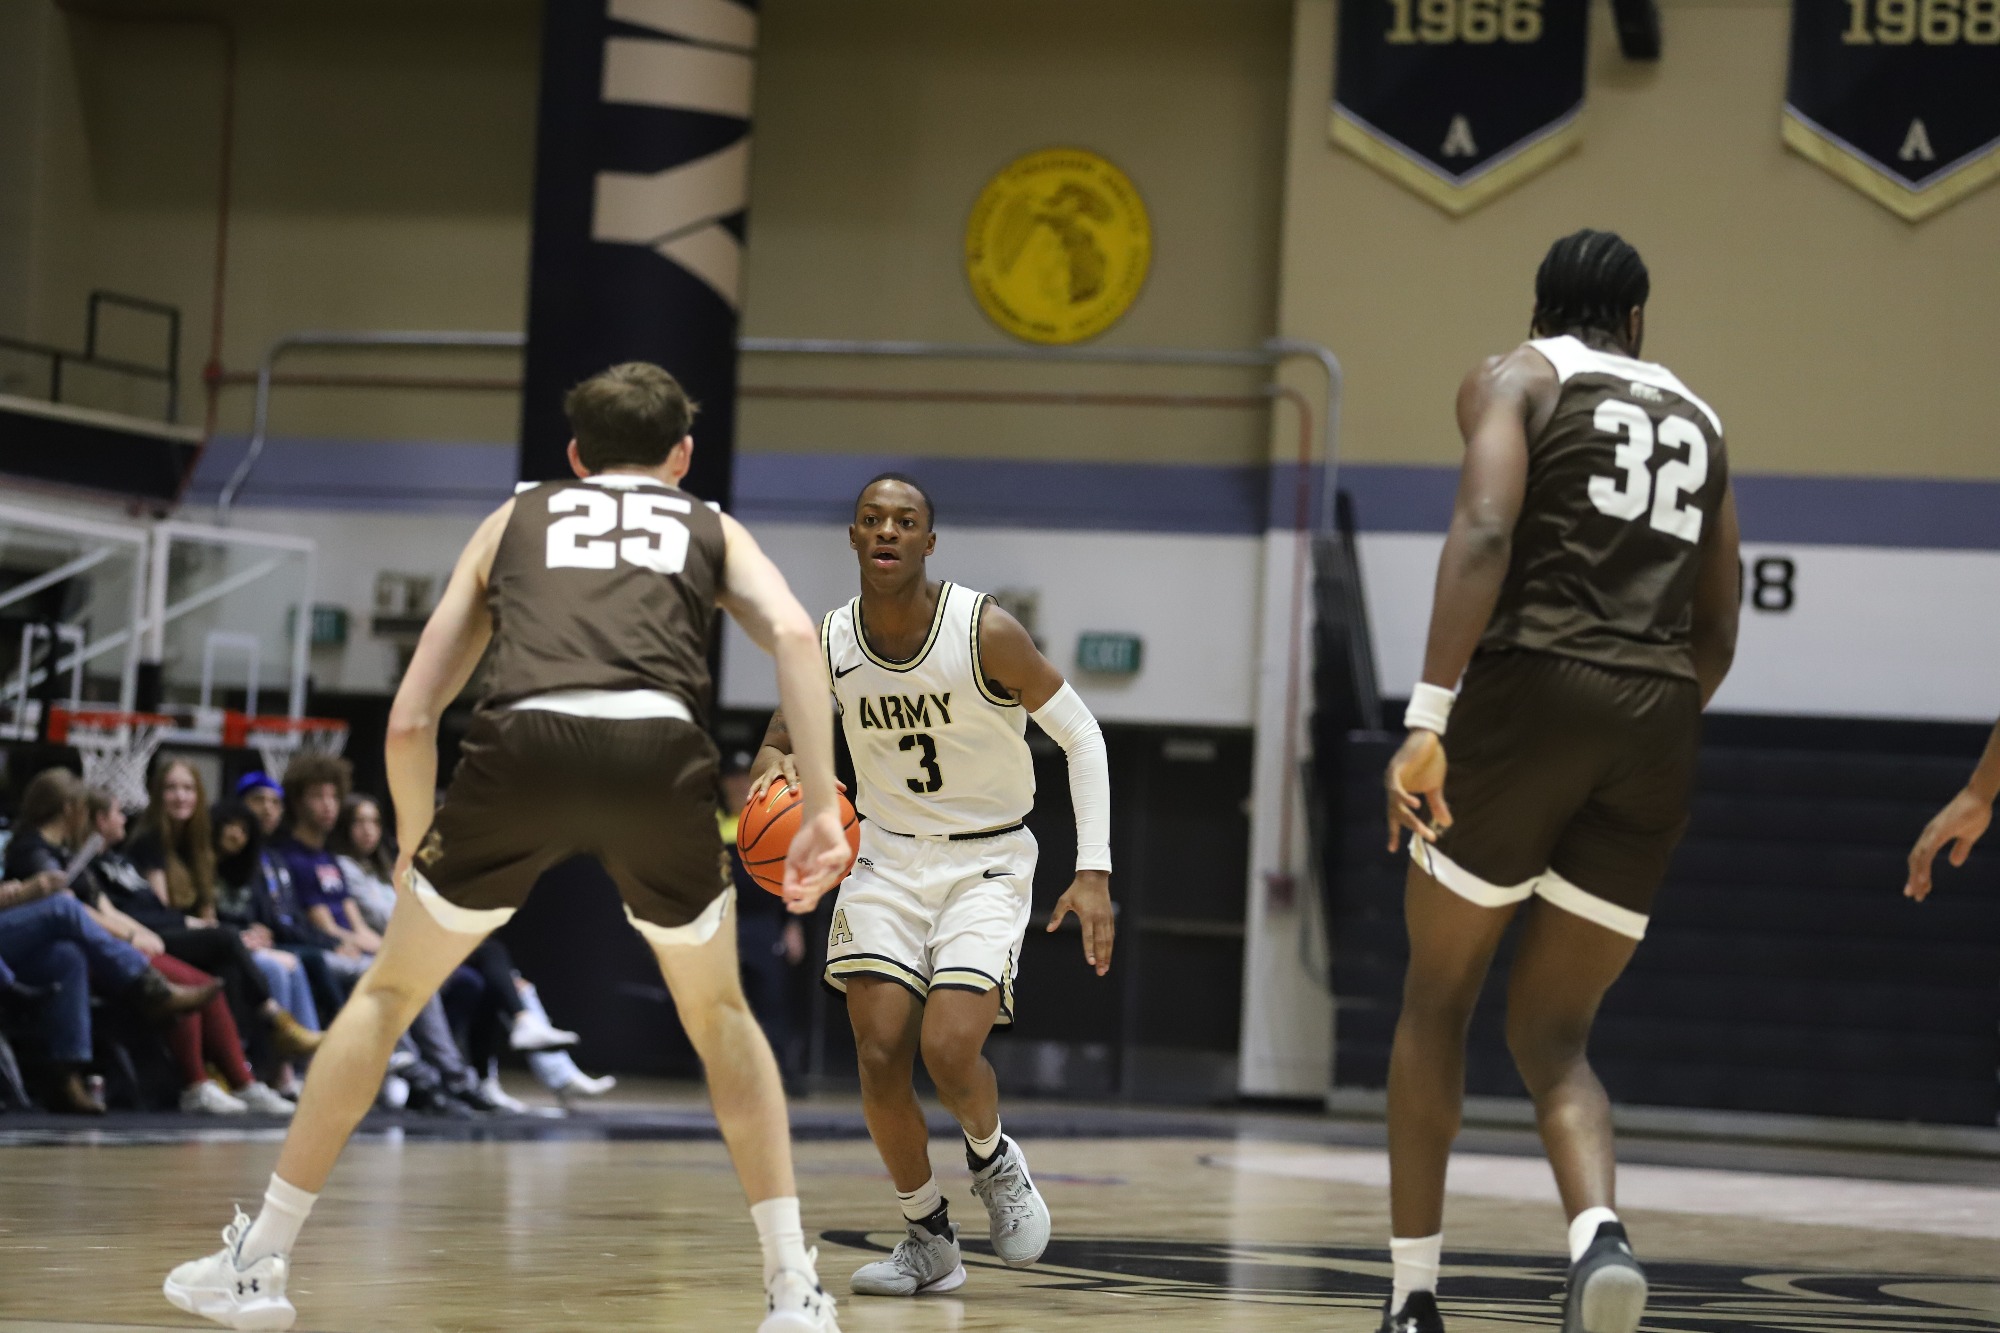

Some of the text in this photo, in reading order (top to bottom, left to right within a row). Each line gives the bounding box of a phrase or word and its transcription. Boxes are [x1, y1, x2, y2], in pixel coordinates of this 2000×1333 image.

[1385, 0, 1543, 44] 1966
[1841, 0, 2000, 45] 1968
[1441, 115, 1478, 156] A
[1899, 119, 1935, 160] A
[1588, 399, 1708, 545] 32
[546, 488, 691, 574] 25
[1738, 557, 1795, 613] 8
[859, 692, 953, 731] ARMY
[898, 733, 944, 794] 3
[830, 908, 853, 947] A
